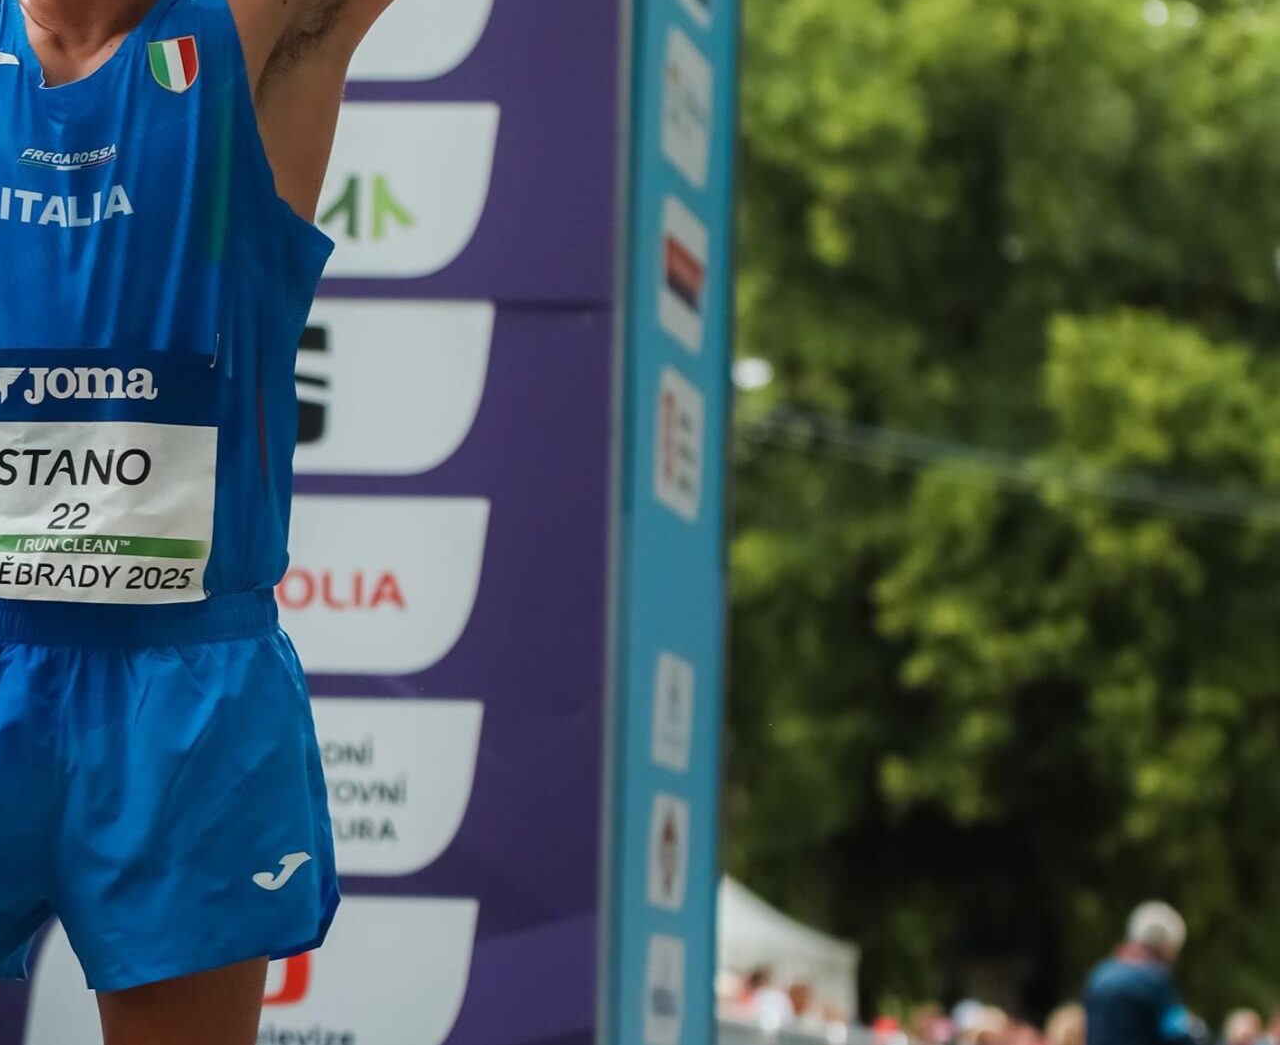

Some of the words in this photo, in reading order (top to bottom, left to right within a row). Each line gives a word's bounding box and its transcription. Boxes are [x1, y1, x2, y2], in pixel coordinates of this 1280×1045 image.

[0, 184, 135, 228] ITALIA
[47, 502, 91, 530] 22
[23, 538, 60, 552] RUN
[125, 565, 195, 590] 2025
[276, 567, 408, 611] OLIA
